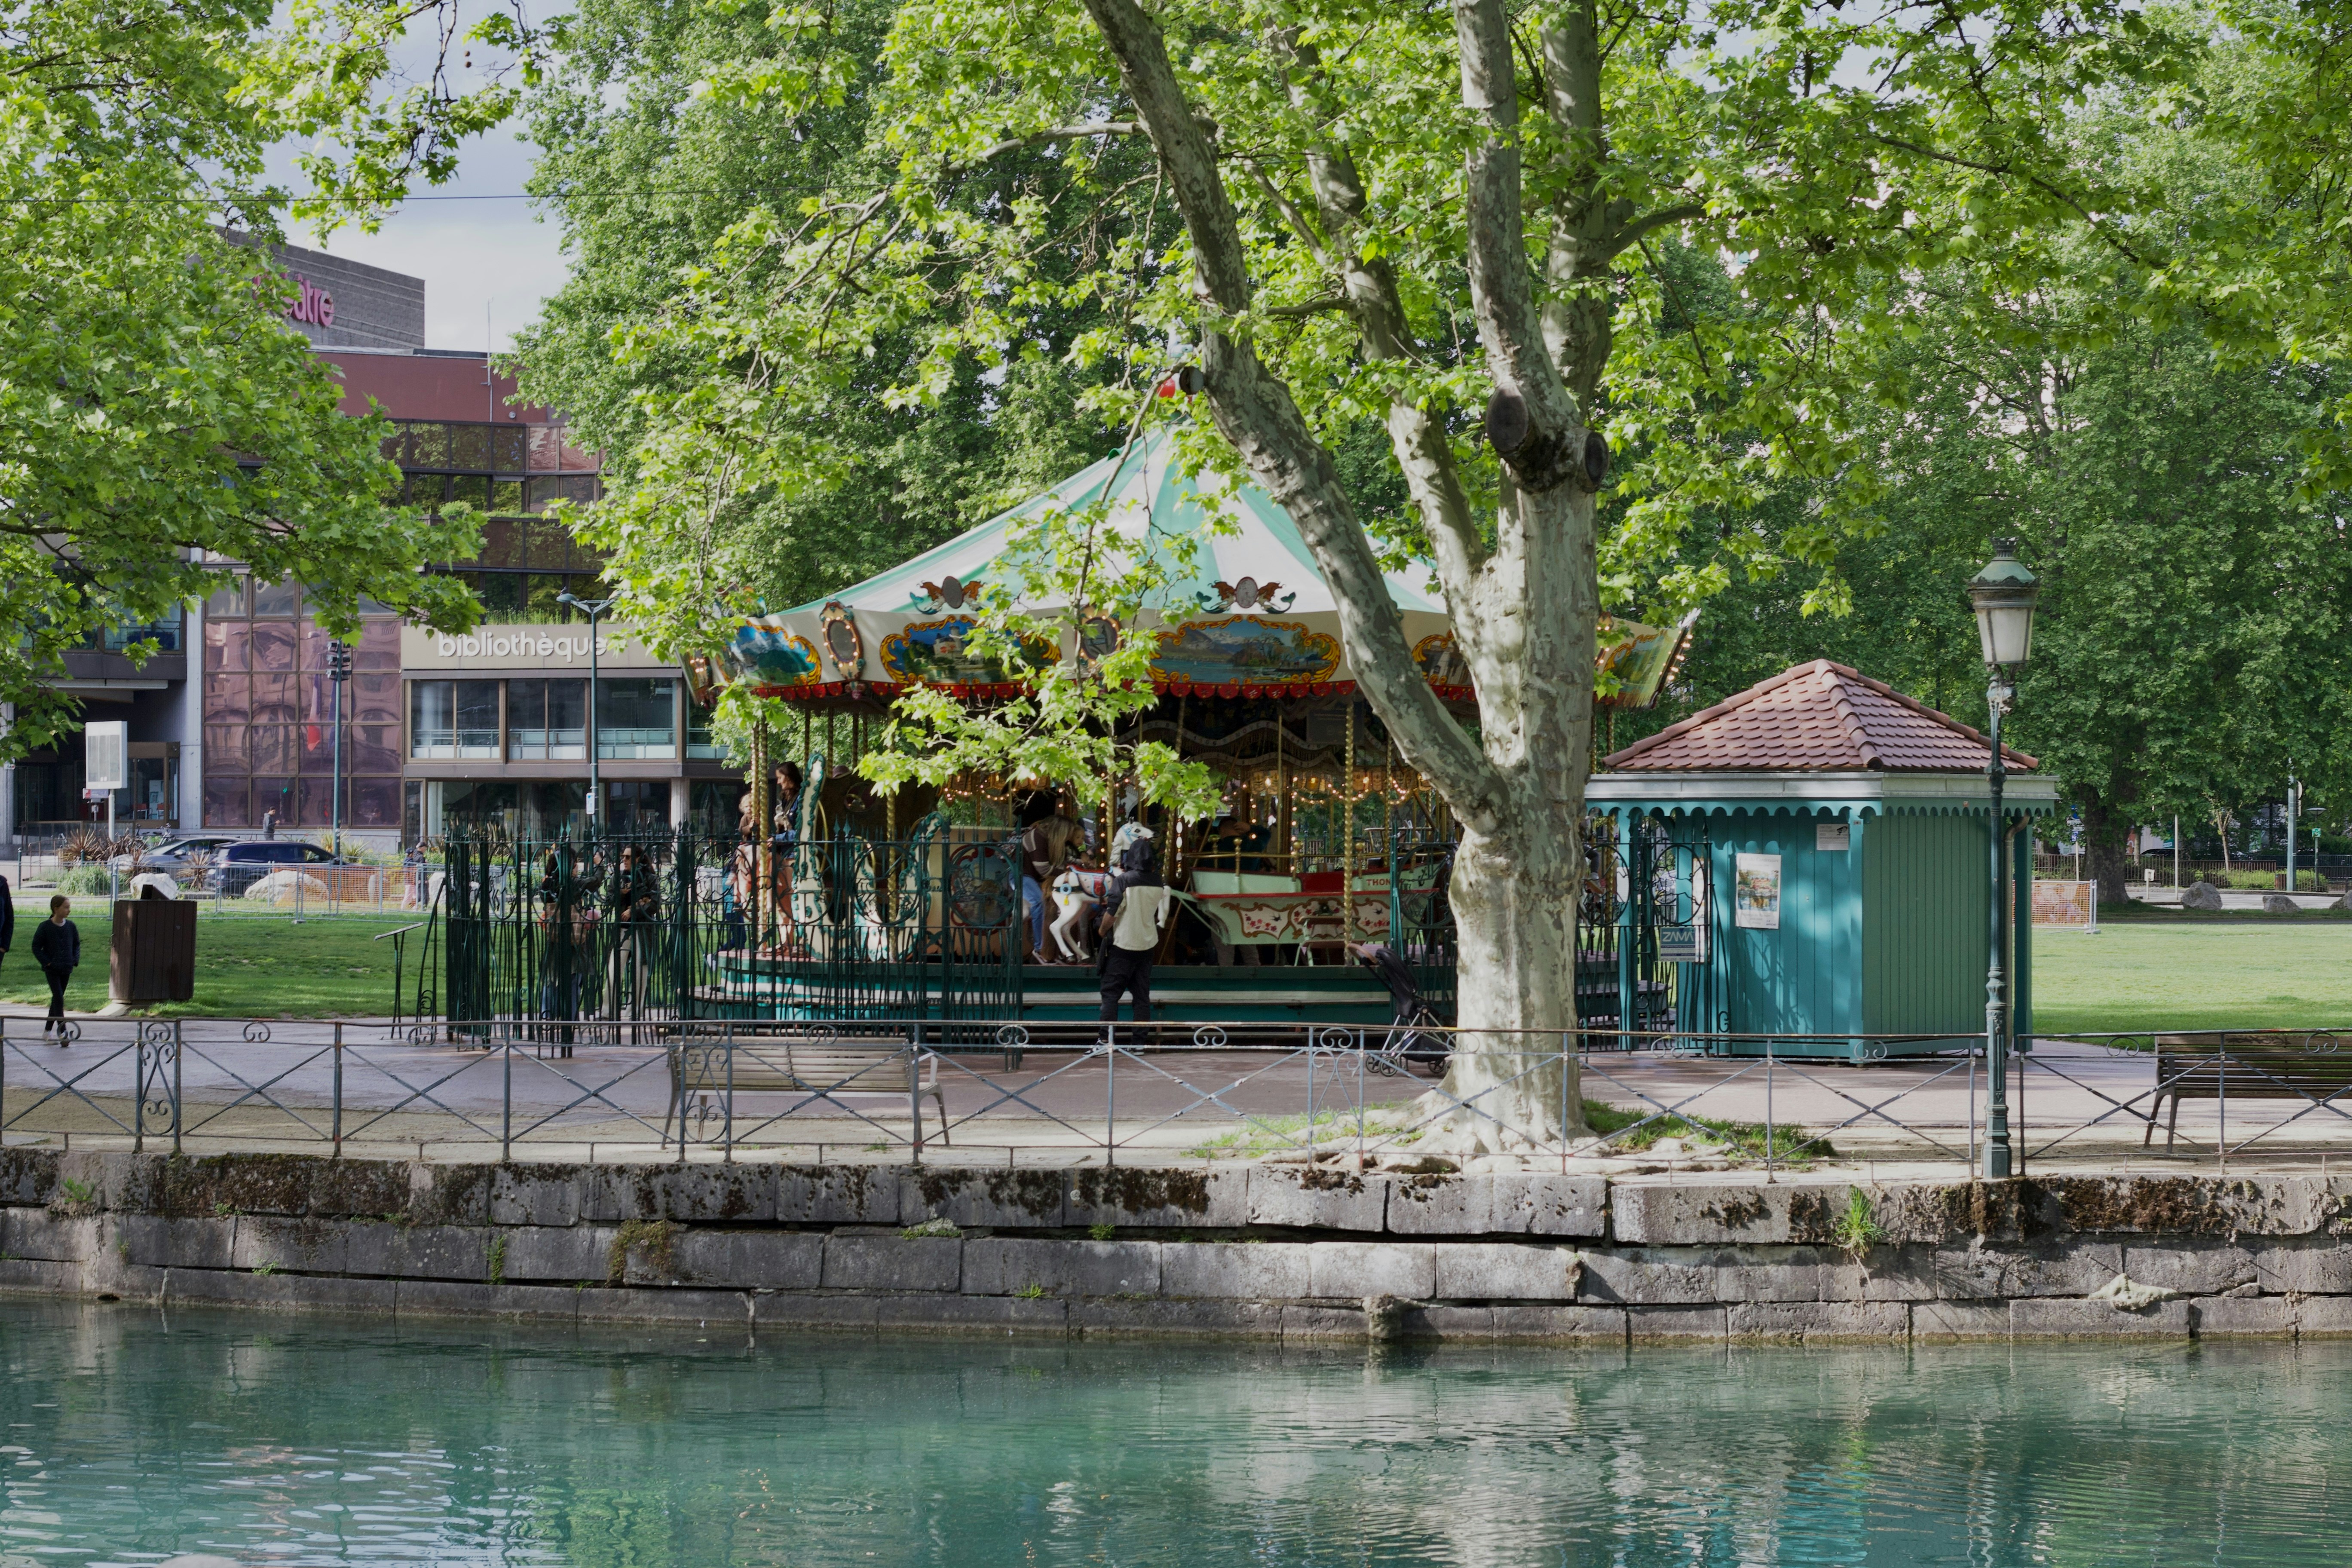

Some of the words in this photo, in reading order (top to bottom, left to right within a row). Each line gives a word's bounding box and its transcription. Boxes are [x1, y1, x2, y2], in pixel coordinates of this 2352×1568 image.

[252, 268, 334, 327] âtre
[438, 631, 607, 663] bibliothèque
[1662, 931, 1694, 942] ZAMA
